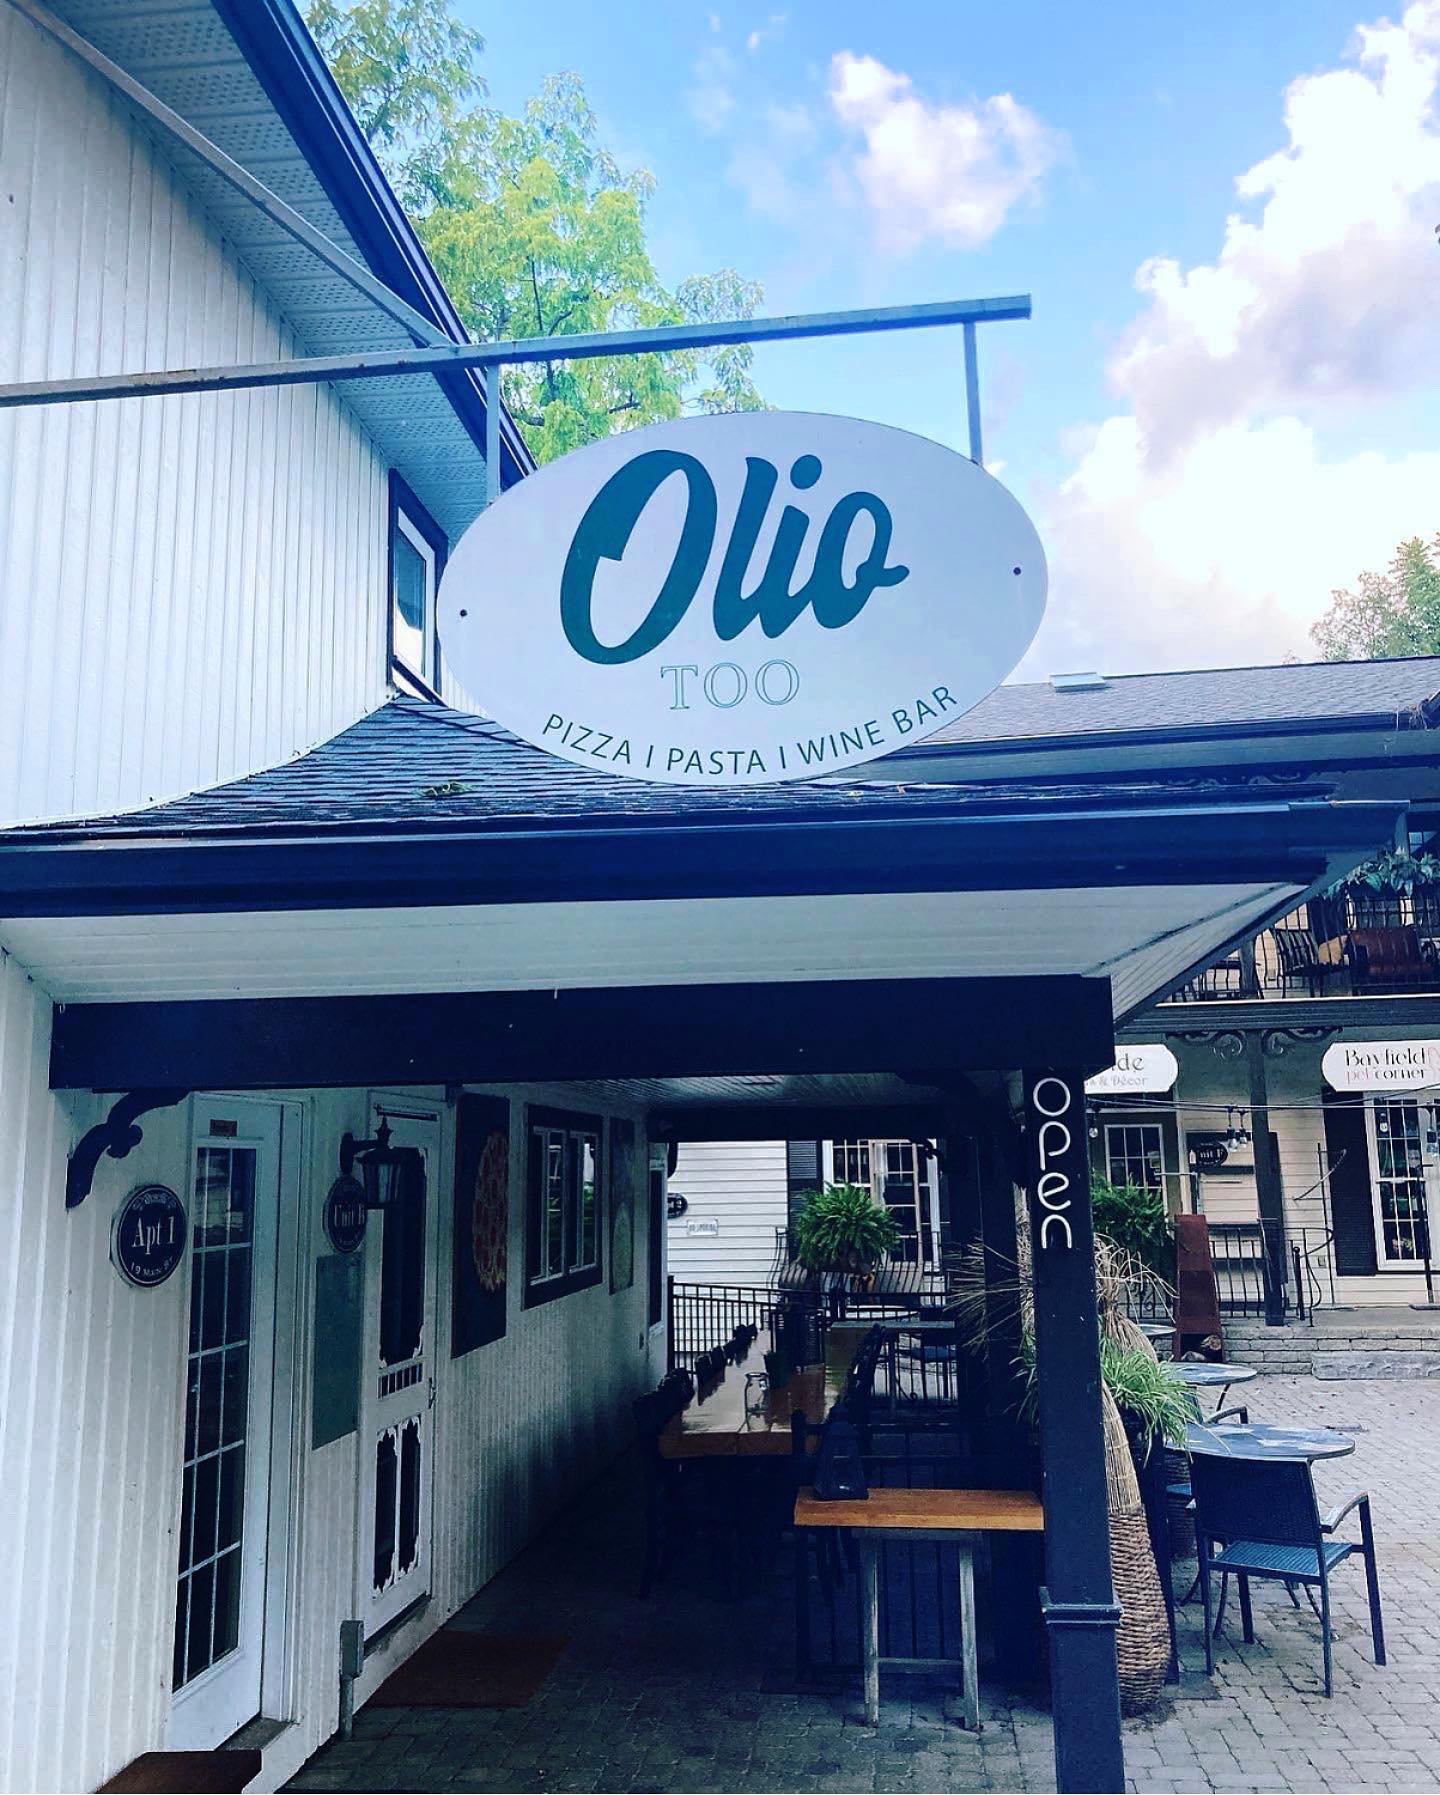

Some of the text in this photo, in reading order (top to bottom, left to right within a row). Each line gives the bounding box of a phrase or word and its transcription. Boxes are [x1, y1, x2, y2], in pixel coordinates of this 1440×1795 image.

[560, 450, 909, 664] Olio
[660, 659, 800, 710] TOO
[543, 713, 632, 764] PIZZA
[668, 750, 766, 774] PASTA
[797, 721, 885, 764] WINE
[893, 685, 957, 734] BAR
[1345, 1048, 1425, 1067] Bayfield
[1345, 1068, 1424, 1085] pet corner
[131, 1215, 175, 1255] Apt 1
